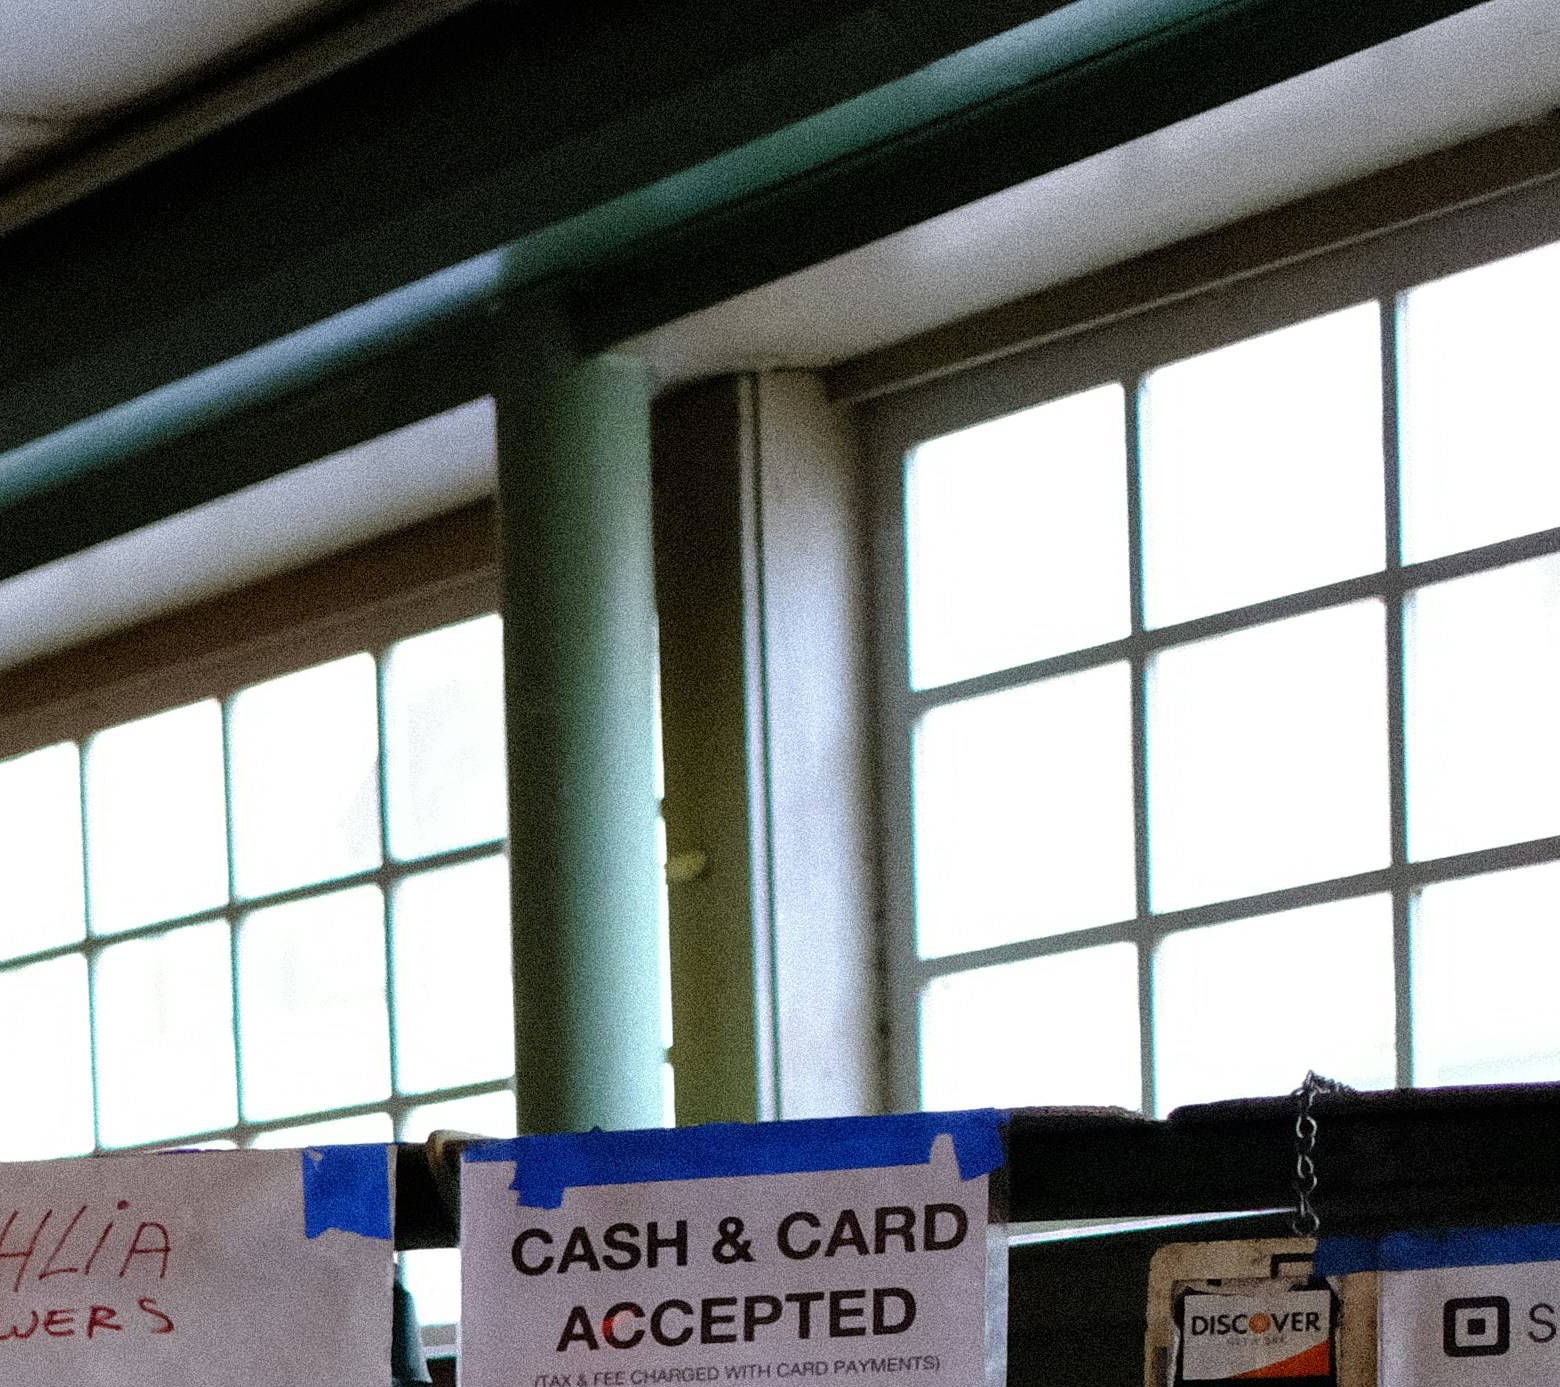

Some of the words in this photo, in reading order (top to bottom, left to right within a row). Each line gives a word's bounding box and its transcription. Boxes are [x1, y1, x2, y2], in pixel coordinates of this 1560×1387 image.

[510, 1219, 689, 1277] CASH
[712, 1215, 756, 1265] &
[776, 1202, 970, 1263] CARD
[555, 1286, 918, 1353] ACCEPTED
[1191, 1311, 1321, 1336] DISCOVER
[593, 1370, 626, 1387] FEE
[630, 1366, 720, 1385] CHARGED
[725, 1364, 771, 1380] WITH
[776, 1361, 829, 1379] CARD
[833, 1355, 942, 1375] PAYMENTS)
